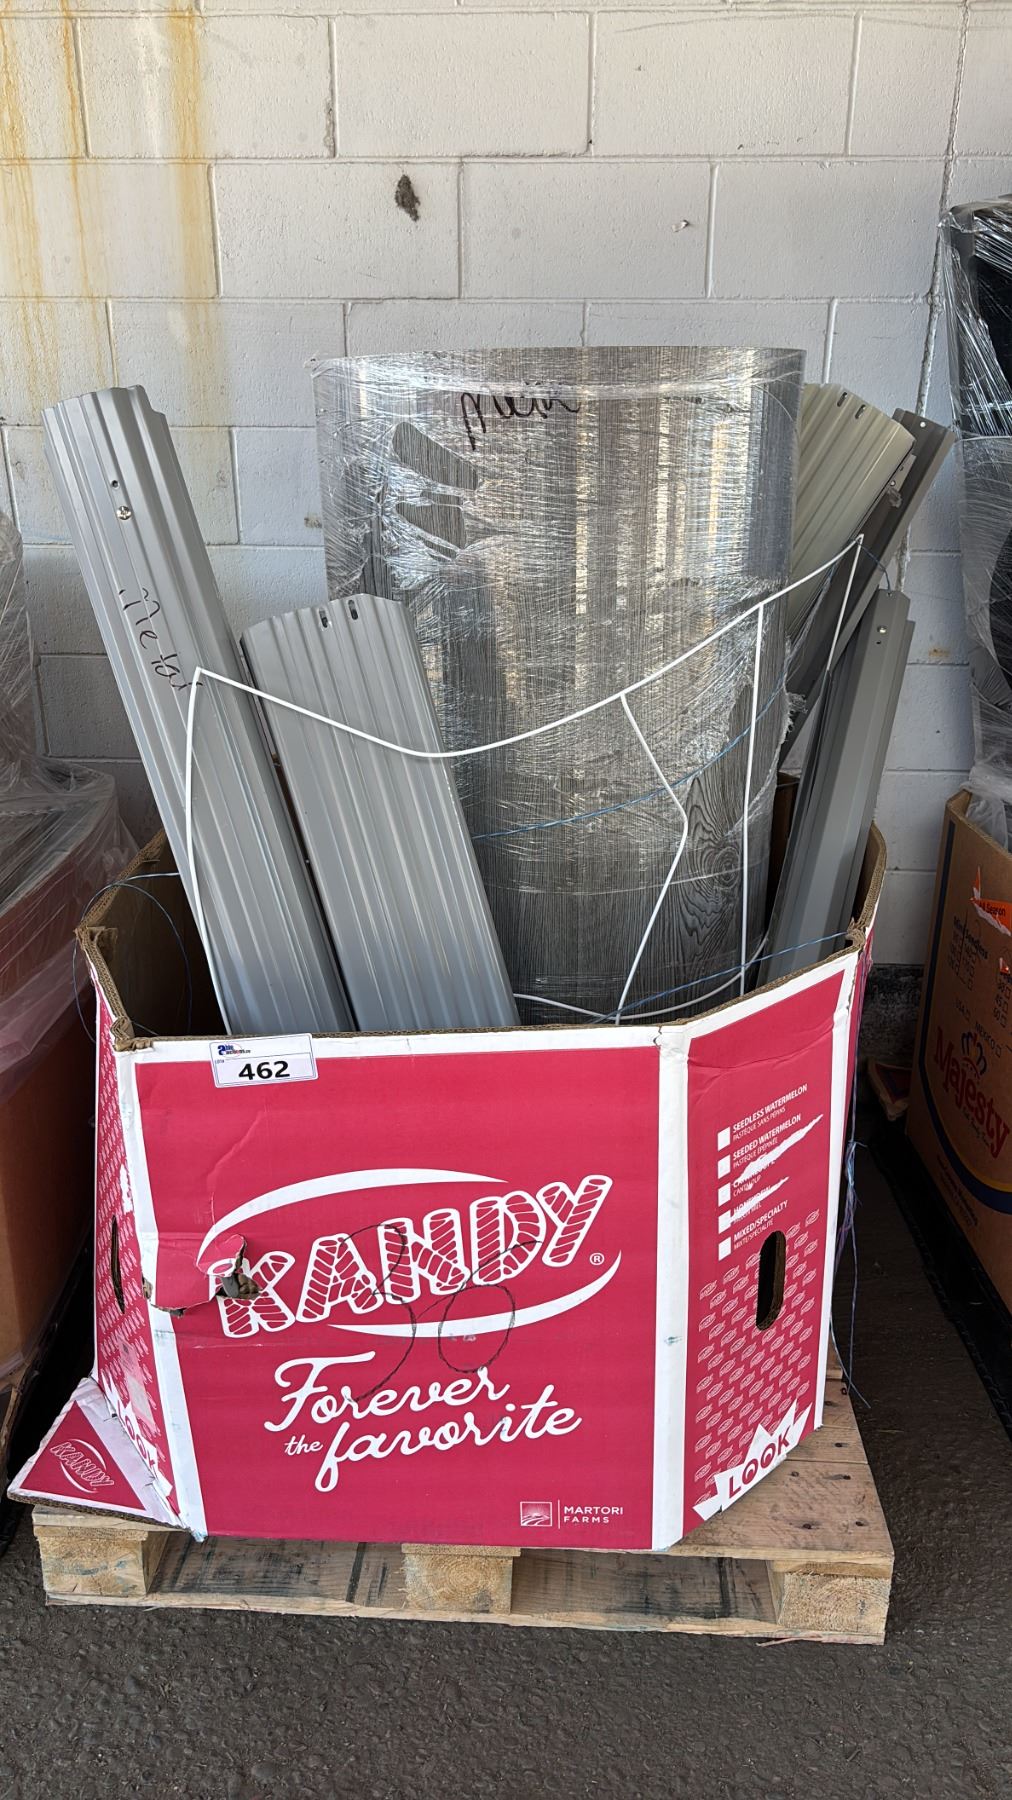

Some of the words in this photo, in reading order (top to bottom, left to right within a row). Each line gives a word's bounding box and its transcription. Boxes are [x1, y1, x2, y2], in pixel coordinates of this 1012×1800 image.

[238, 1060, 291, 1081] 462
[935, 1026, 1010, 1159] Majesty
[733, 1108, 765, 1133] SEEDLESS
[764, 1083, 808, 1115] WATERMELON
[733, 1139, 759, 1161] SEEDED
[758, 1113, 802, 1145] WATERMELON
[734, 1200, 788, 1242] MIXED/SPECIALTY
[207, 1175, 613, 1338] KANDY
[264, 1350, 510, 1432] Forever
[284, 1434, 323, 1456] the
[314, 1384, 582, 1493] favorite
[729, 1425, 790, 1498] LOOK
[50, 1442, 115, 1487] KANDY
[563, 1506, 624, 1515] MARTORI
[563, 1516, 610, 1524] FARMS
